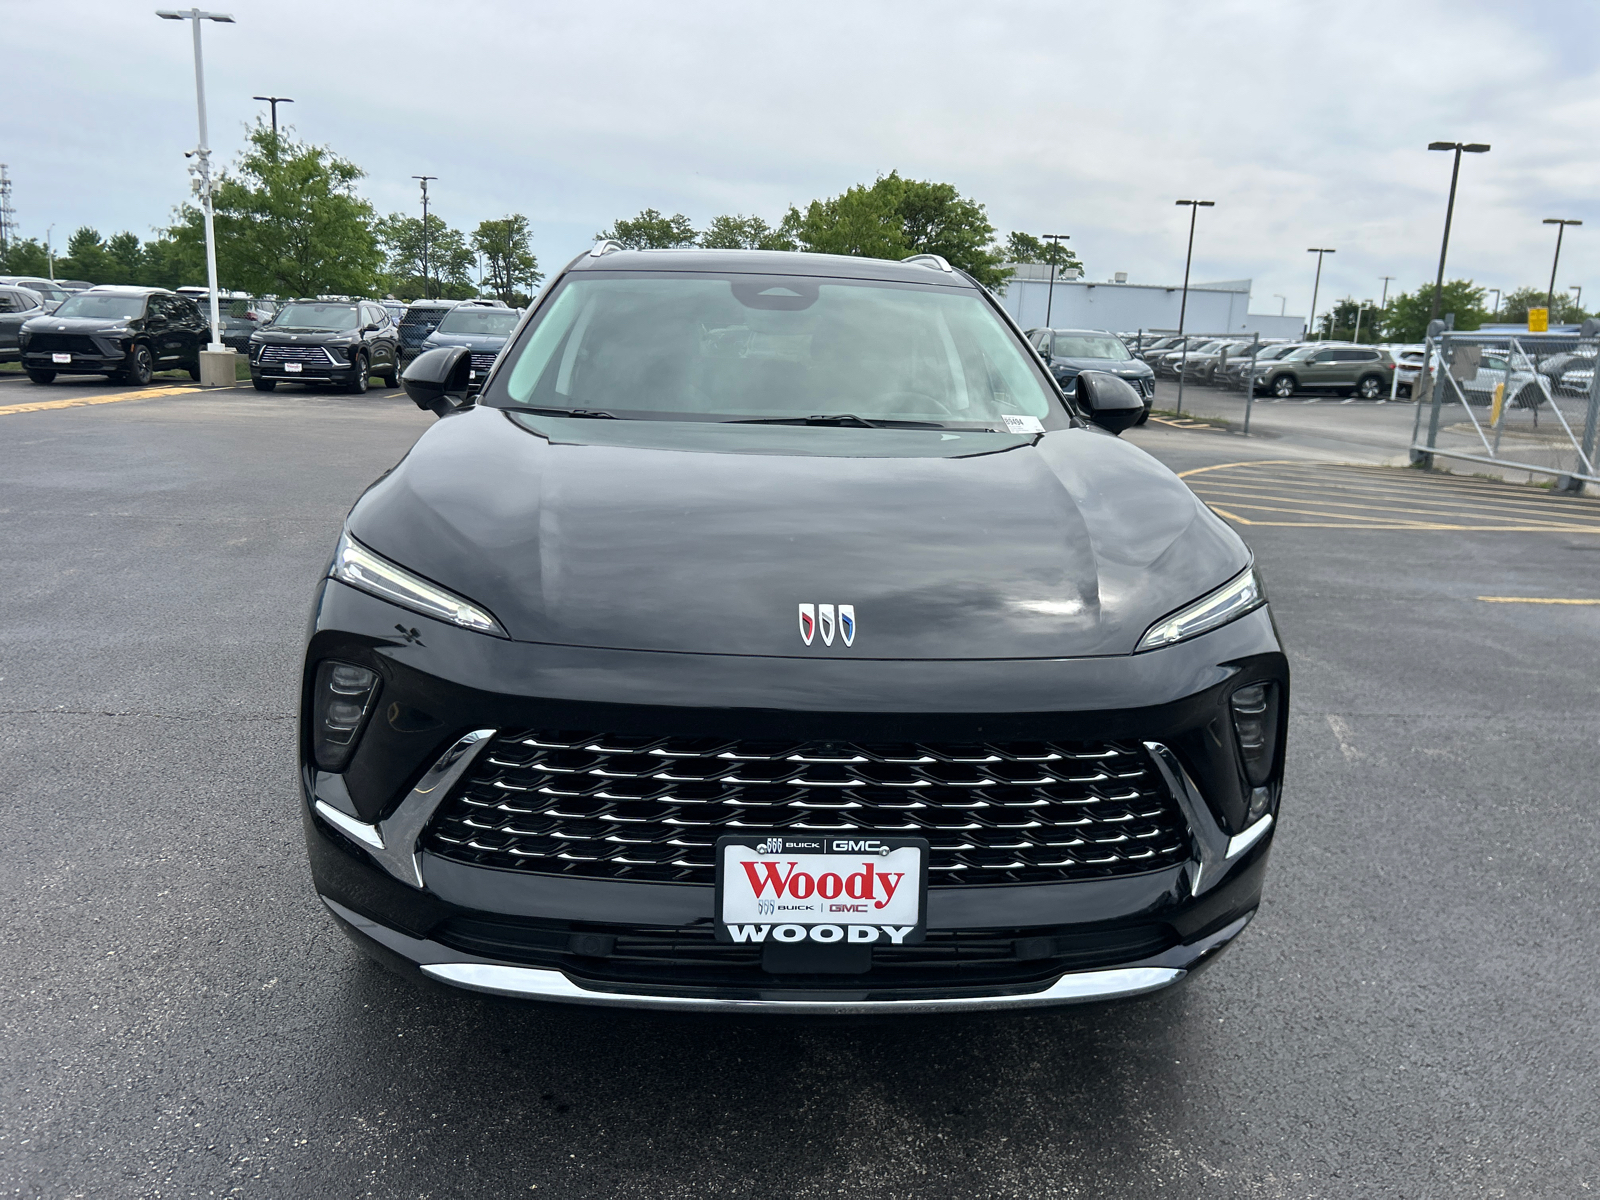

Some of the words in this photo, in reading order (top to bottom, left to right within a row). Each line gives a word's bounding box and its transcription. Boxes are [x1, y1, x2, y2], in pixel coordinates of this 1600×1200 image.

[832, 840, 881, 852] GMC
[740, 861, 905, 910] Woody
[829, 904, 868, 913] GMC
[726, 924, 915, 944] WOODY
